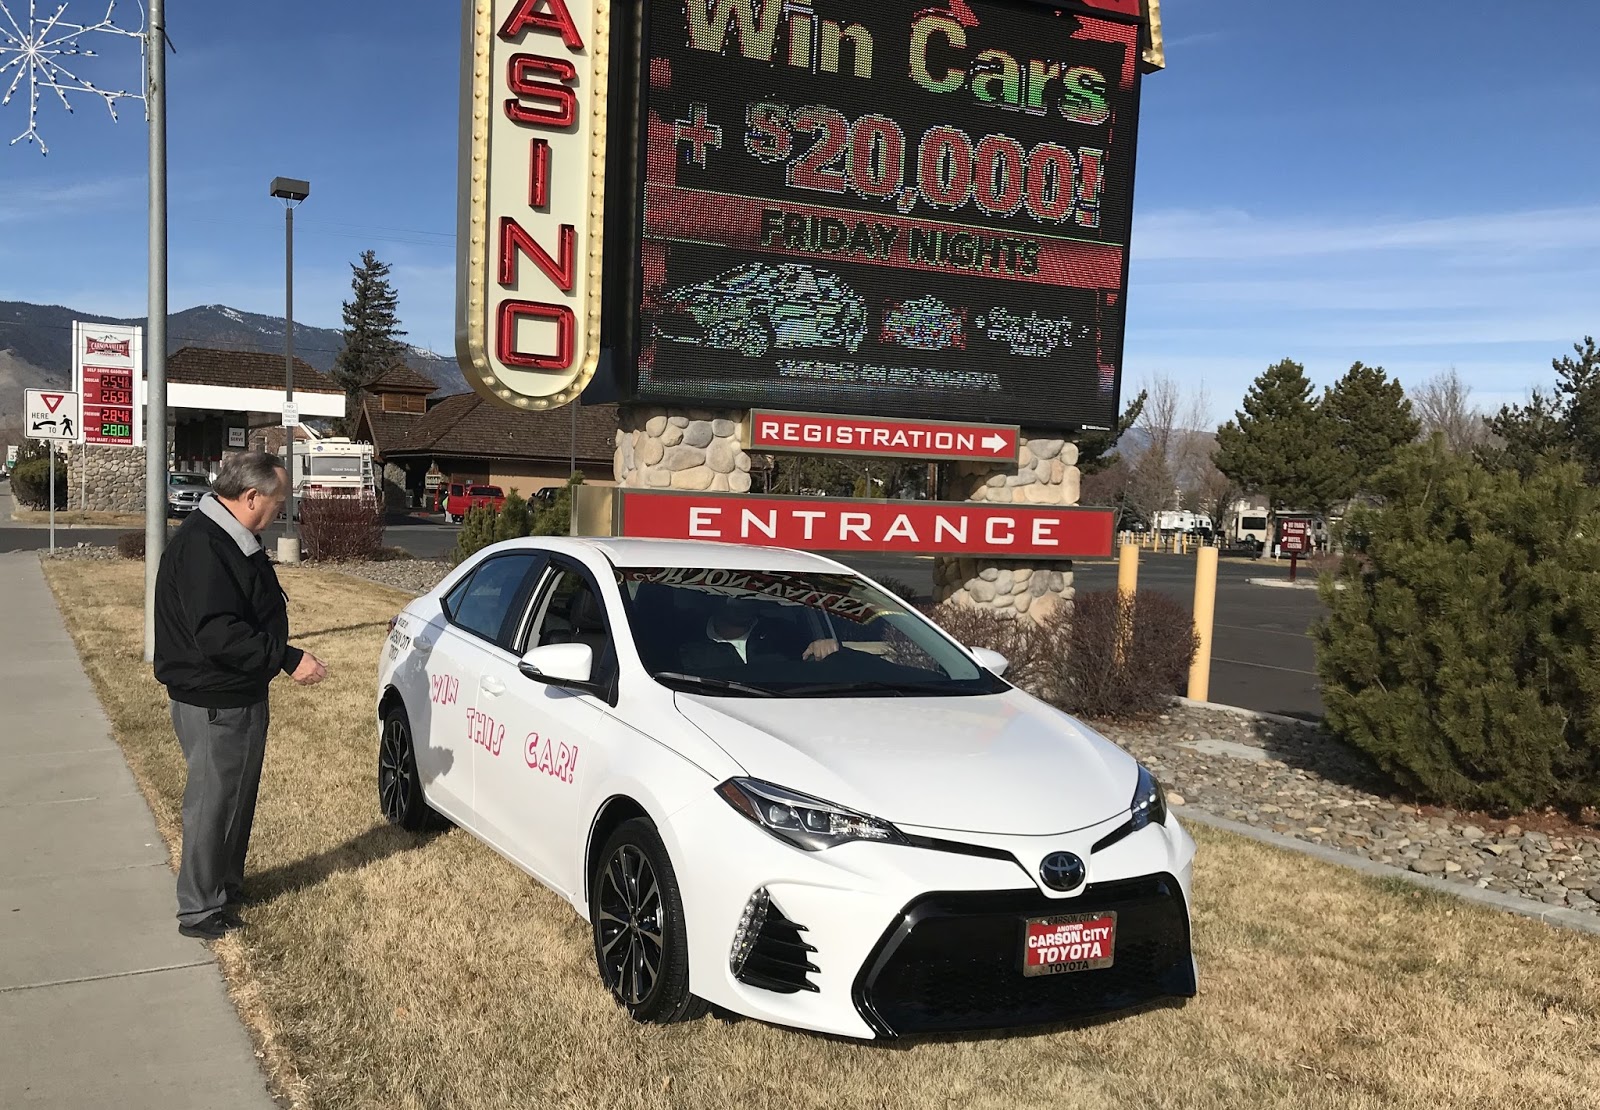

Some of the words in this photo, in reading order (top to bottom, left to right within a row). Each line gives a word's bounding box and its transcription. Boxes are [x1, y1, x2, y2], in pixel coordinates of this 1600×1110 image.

[683, 0, 874, 79] Win
[908, 14, 1109, 125] Cars
[744, 98, 1105, 229] $20,000!
[760, 207, 901, 261] FRIDAY
[907, 226, 1041, 277] NIGHTS
[31, 412, 49, 420] HERE
[48, 426, 57, 434] TO
[761, 420, 975, 451] REGISTRATION
[688, 506, 1060, 547] ENTRANCE
[431, 674, 460, 705] WIN
[466, 707, 506, 757] THIS
[523, 732, 579, 784] CAR!
[1028, 930, 1080, 949] CARSON
[1082, 927, 1109, 943] CITY
[1056, 923, 1084, 933] ANOTHER
[1037, 941, 1102, 965] TOYOTA
[1048, 960, 1089, 974] TOYOTA
